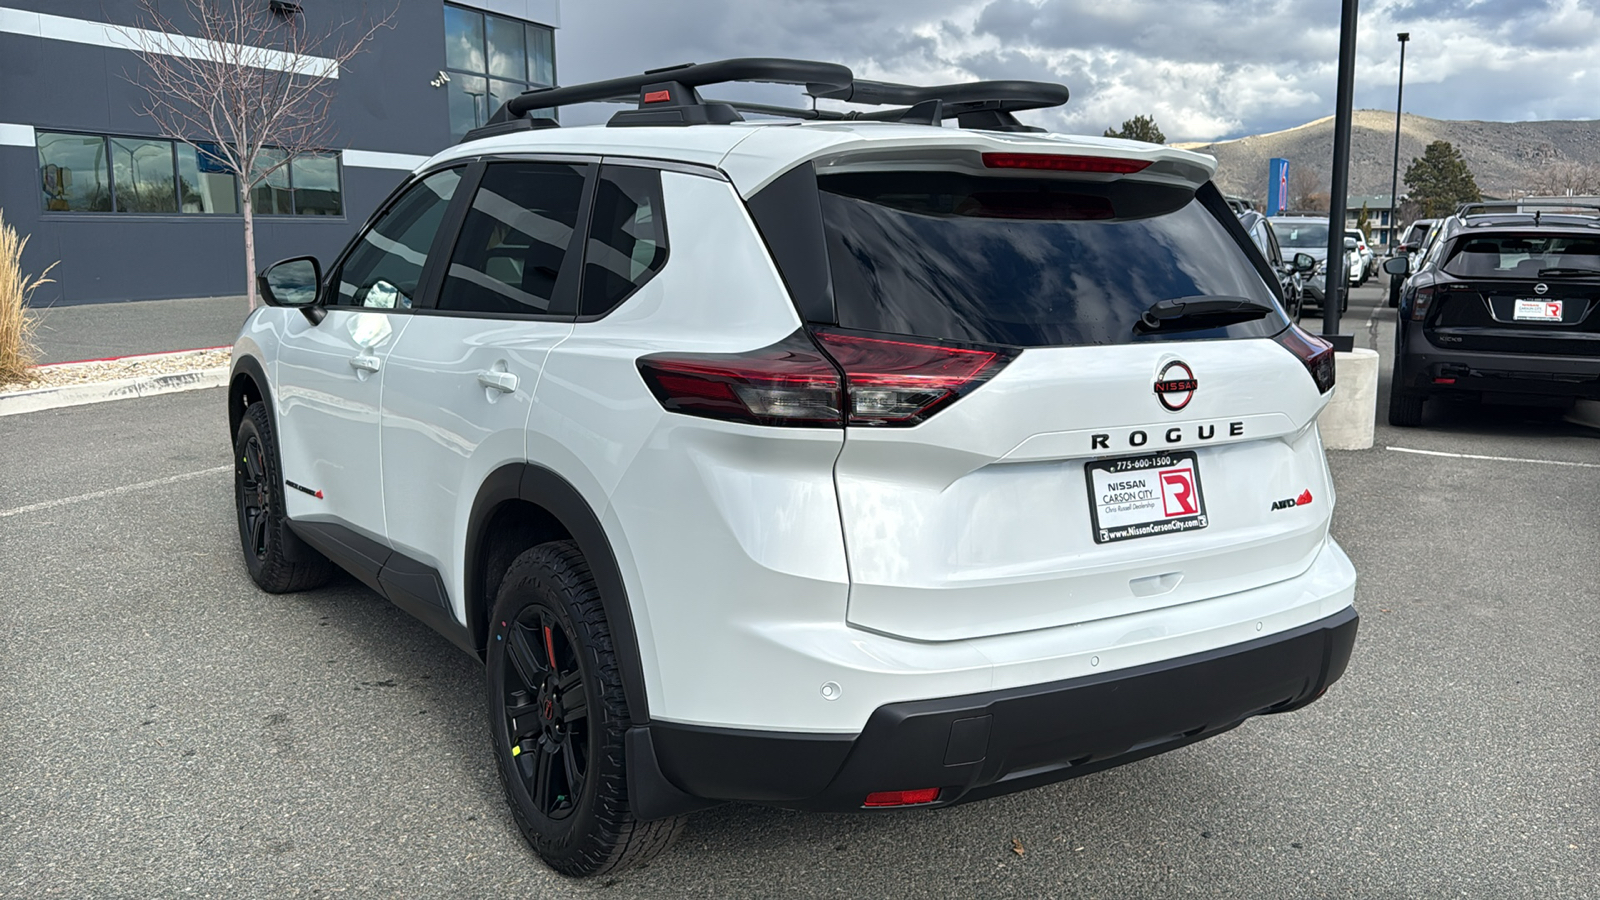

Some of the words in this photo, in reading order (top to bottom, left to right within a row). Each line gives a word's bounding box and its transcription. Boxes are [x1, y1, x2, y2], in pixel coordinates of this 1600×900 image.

[1155, 380, 1197, 391] NISSAN
[1091, 421, 1244, 450] ROGUE
[1116, 456, 1171, 470] 775-600-1500
[1108, 479, 1146, 492] NISSAN
[1102, 491, 1136, 504] CARSON
[1137, 489, 1154, 500] CITY
[1105, 505, 1117, 513] Chris
[1117, 504, 1132, 512] Russell
[1132, 502, 1155, 511] Dealership
[1109, 518, 1199, 538] www.NissanCarsonCity.com
